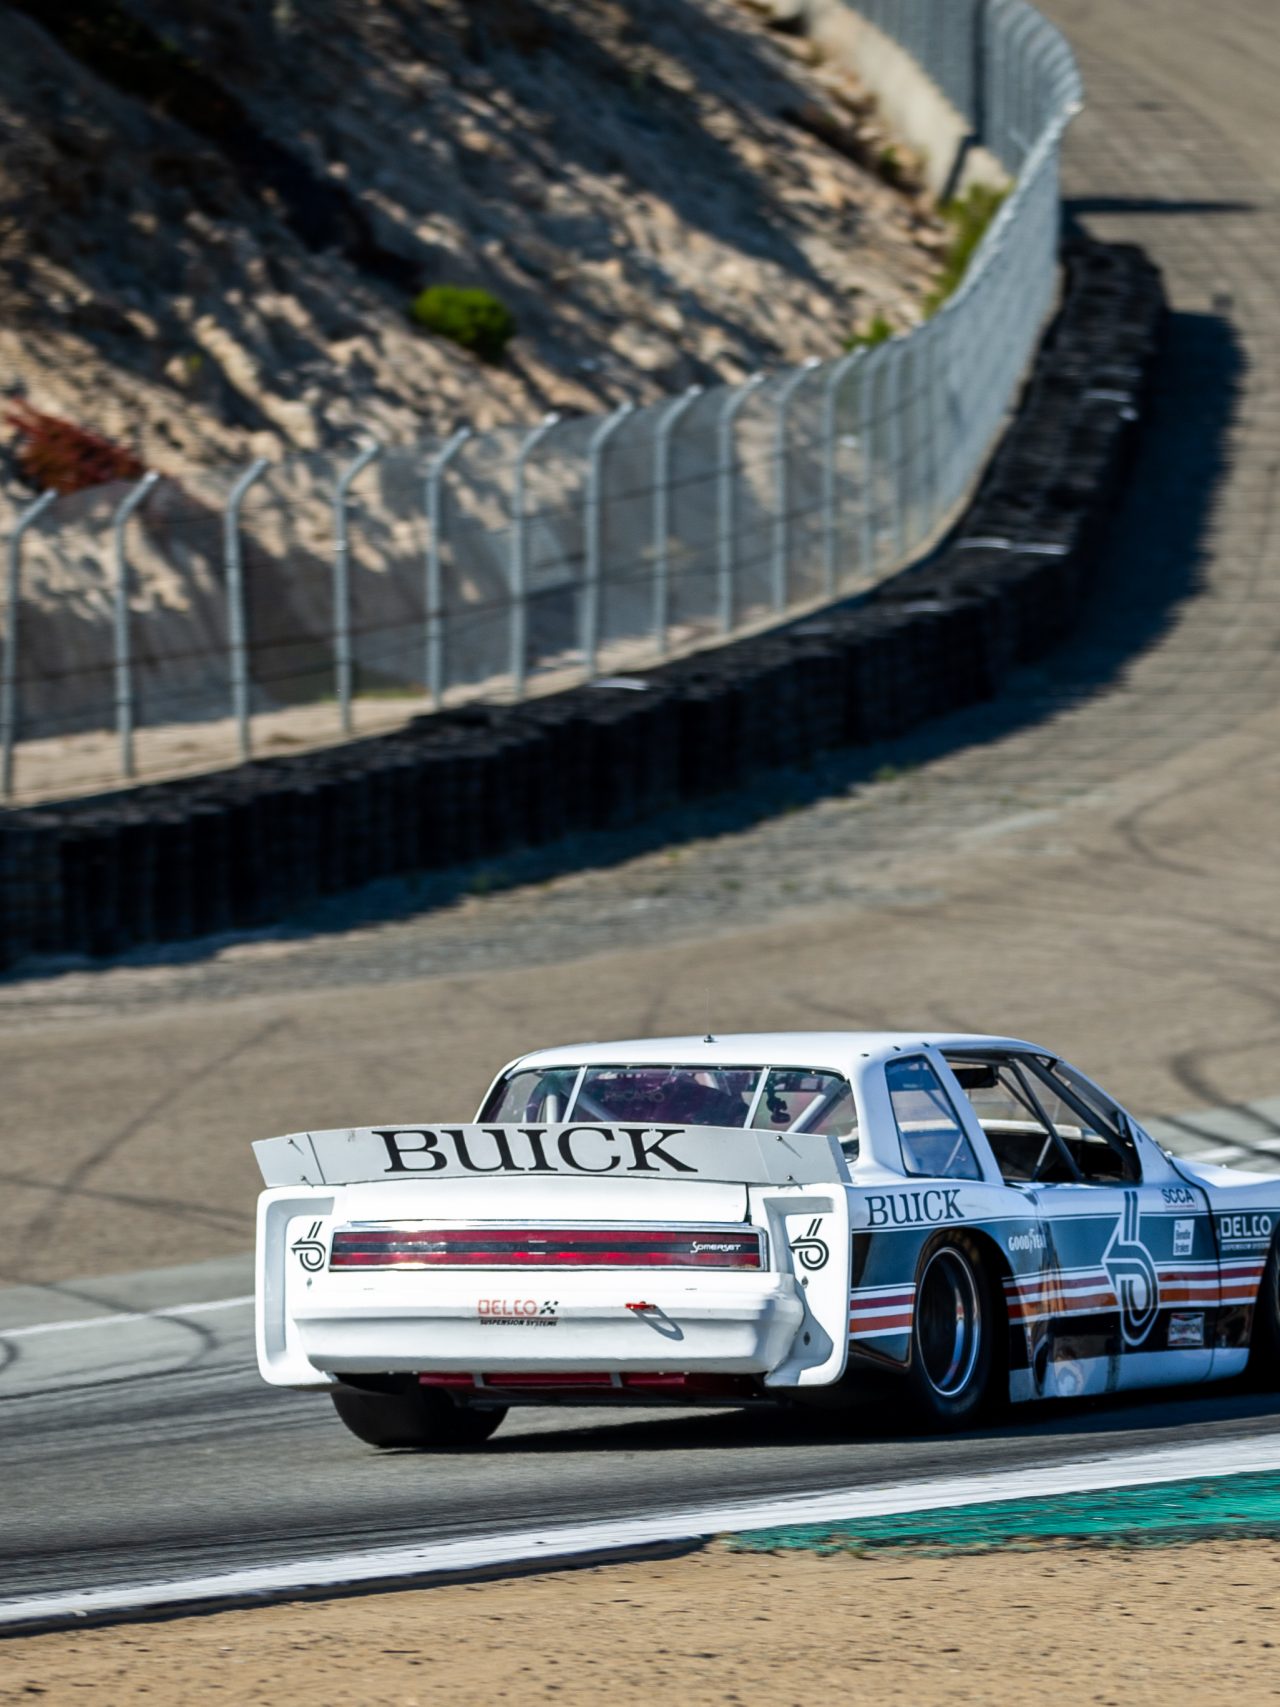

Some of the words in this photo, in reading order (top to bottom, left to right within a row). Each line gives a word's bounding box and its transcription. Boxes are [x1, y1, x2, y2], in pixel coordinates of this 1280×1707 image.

[371, 1126, 699, 1173] BUICK
[864, 1188, 965, 1226] BUICK
[1161, 1188, 1195, 1204] SCCA
[1220, 1215, 1272, 1237] DELCO
[478, 1299, 537, 1316] DELCO
